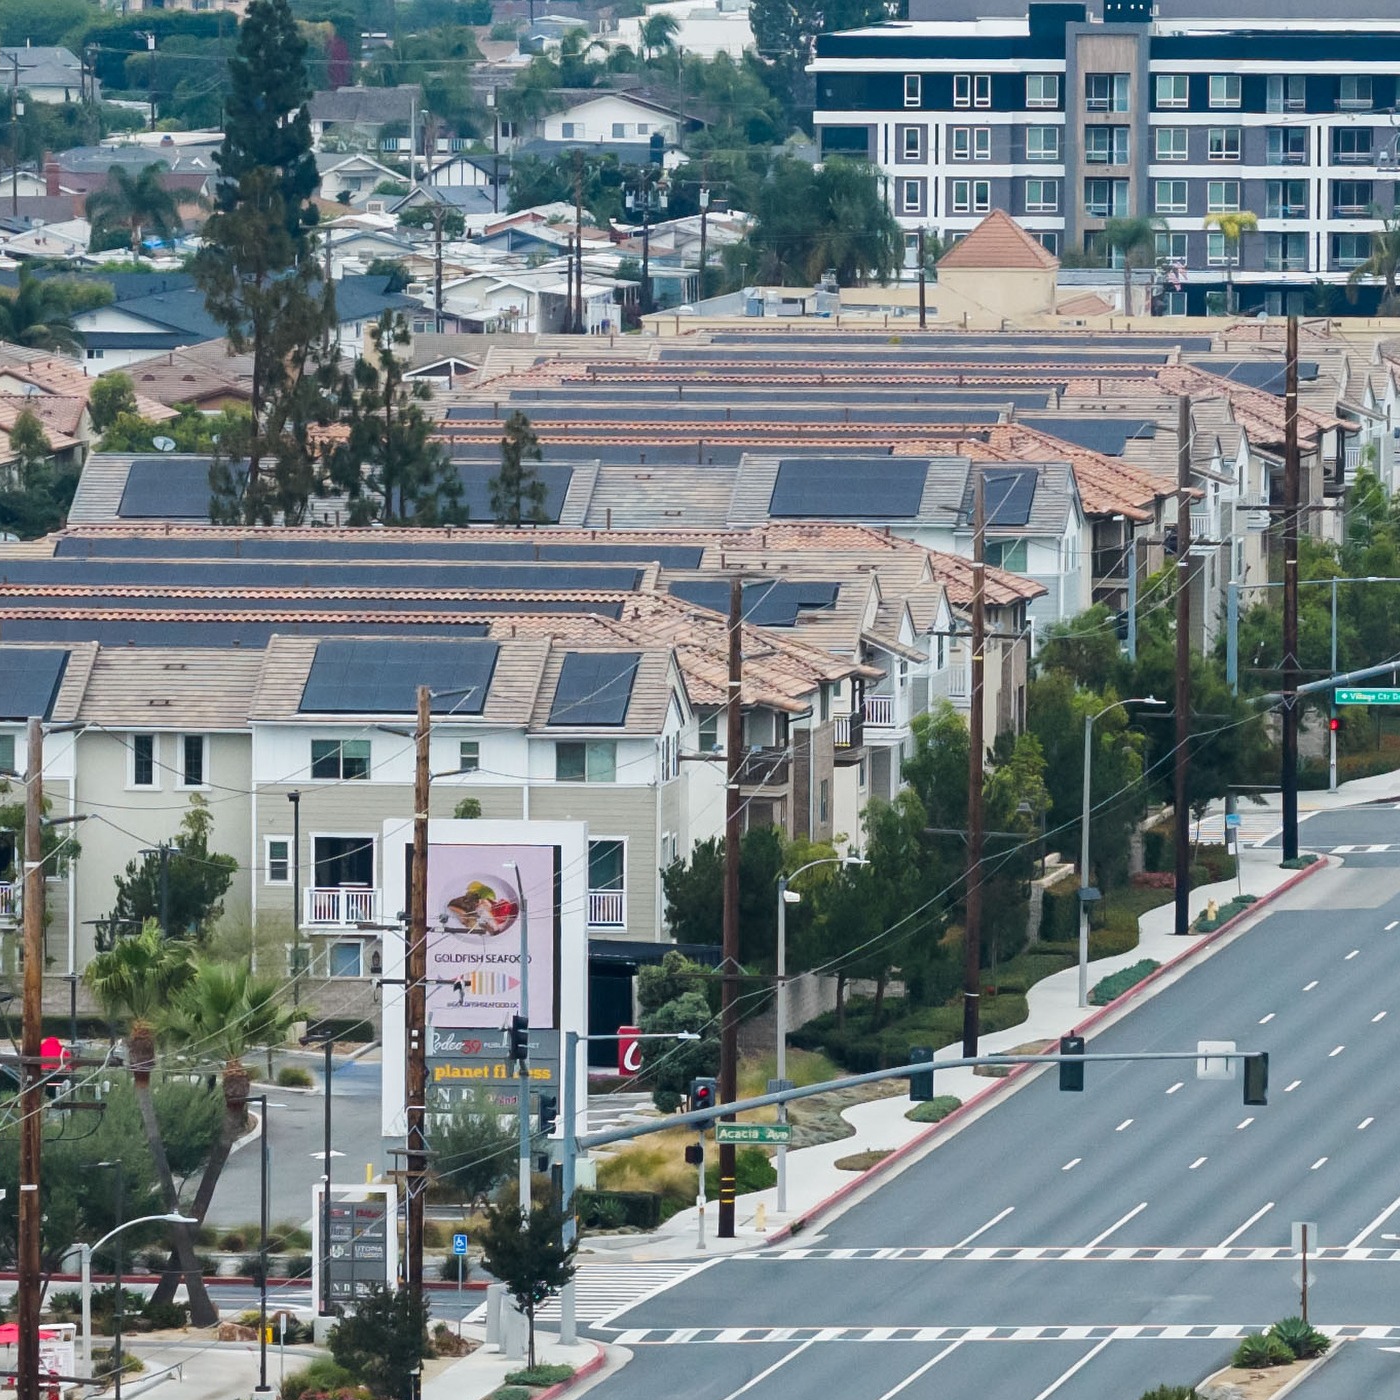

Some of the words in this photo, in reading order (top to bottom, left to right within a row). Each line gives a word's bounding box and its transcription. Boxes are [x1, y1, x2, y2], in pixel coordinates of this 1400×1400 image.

[434, 953, 484, 963] GOLDFISH
[434, 1063, 489, 1081] planet
[719, 1128, 759, 1139] Acacia
[766, 1128, 788, 1140] Ave
